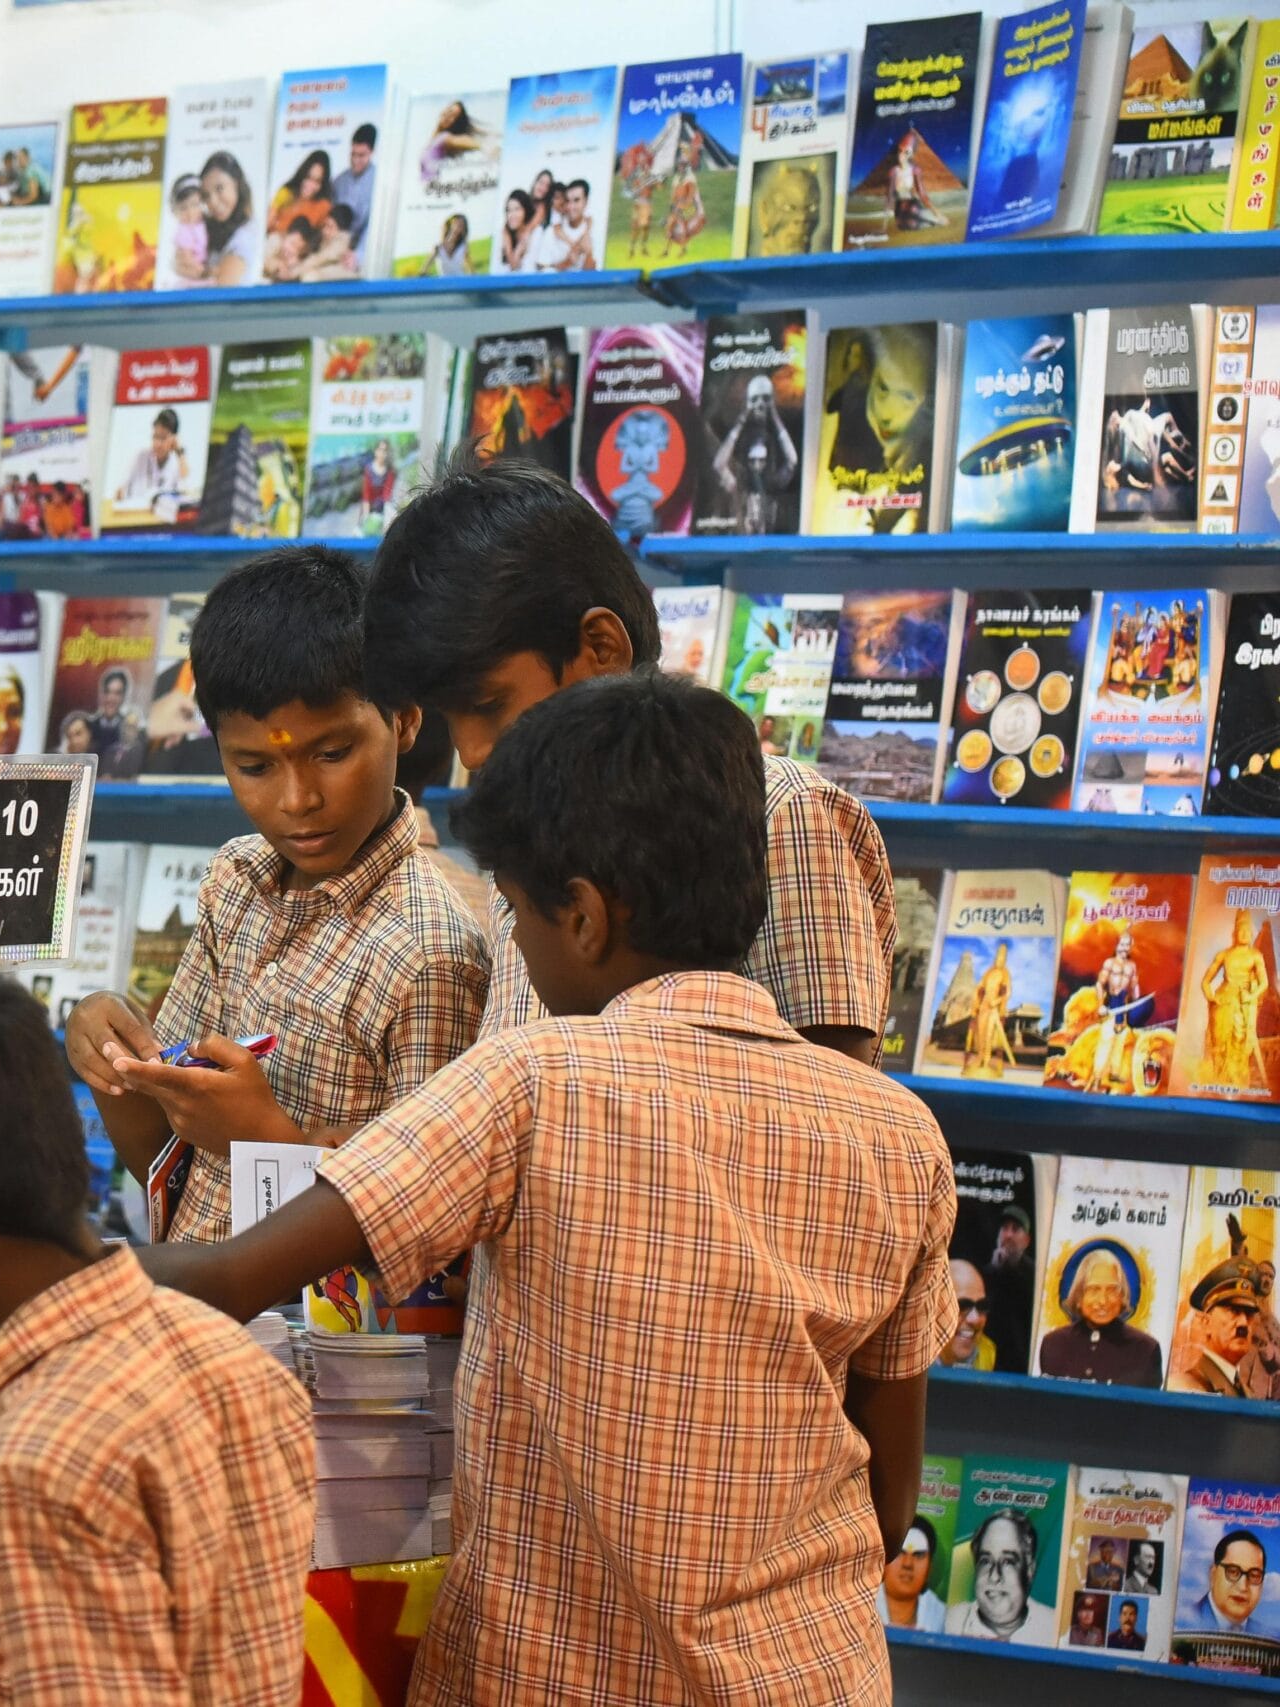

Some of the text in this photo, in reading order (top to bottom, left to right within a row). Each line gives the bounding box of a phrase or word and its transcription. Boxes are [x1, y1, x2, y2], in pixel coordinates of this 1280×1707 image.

[1147, 115, 1223, 141] மர்மங்கள்
[1116, 319, 1190, 357] மரணத்திற்கு
[595, 364, 664, 386] மறுபிறவி
[976, 364, 1065, 398] பறக்கும் தட்டு
[1143, 361, 1190, 389] அப்பால்
[593, 383, 682, 405] மர்மங்களும்
[2, 800, 39, 837] 10
[1072, 1199, 1167, 1226] அப்துல் கலாம்
